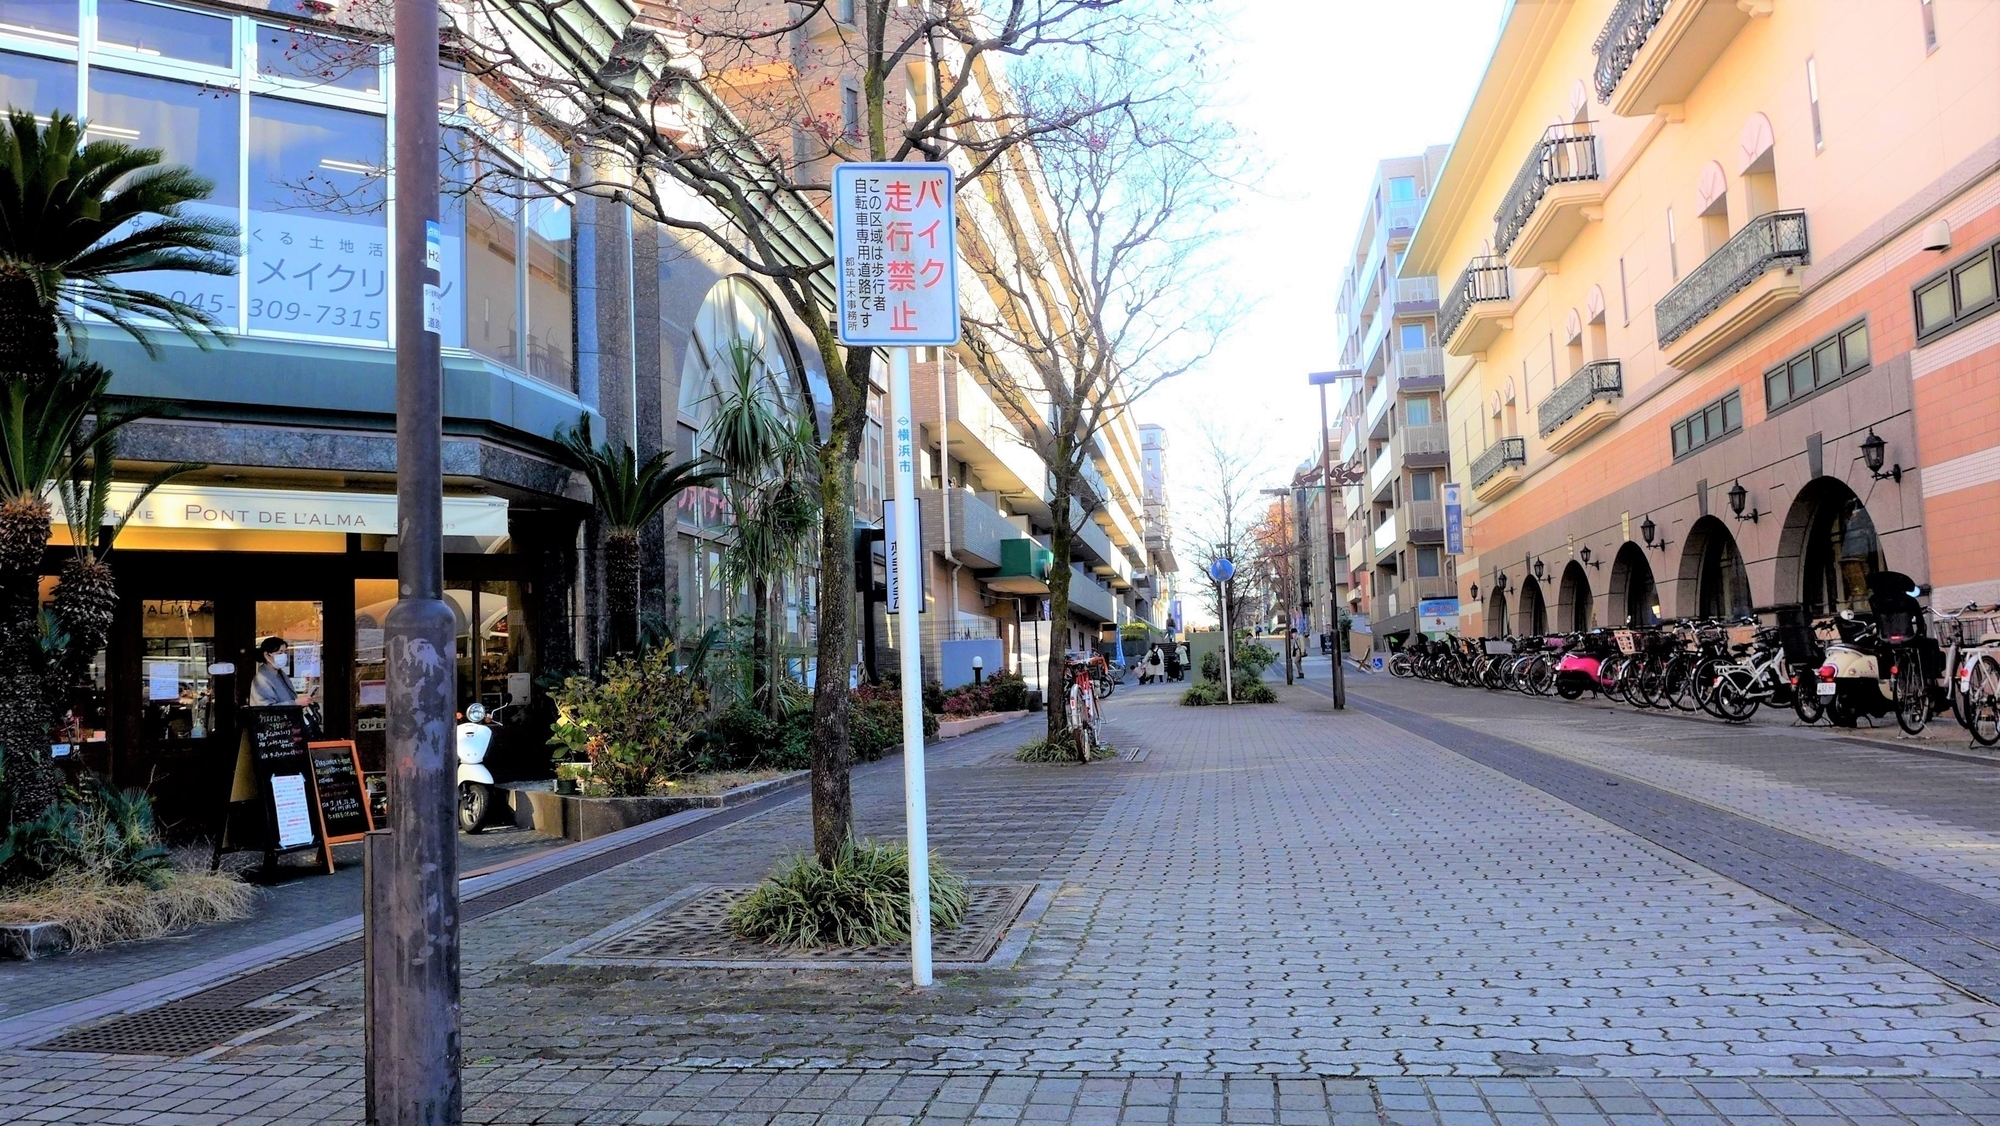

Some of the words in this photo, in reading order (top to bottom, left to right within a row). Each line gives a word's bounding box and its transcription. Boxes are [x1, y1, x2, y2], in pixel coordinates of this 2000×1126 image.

[844, 256, 858, 332] 都筑土木事務所
[854, 178, 873, 329] 自転車専用道路です
[868, 178, 887, 312] この区域は歩行者
[884, 180, 918, 332] 走行禁止
[915, 178, 946, 289] バイク
[897, 428, 911, 474] 横浜市
